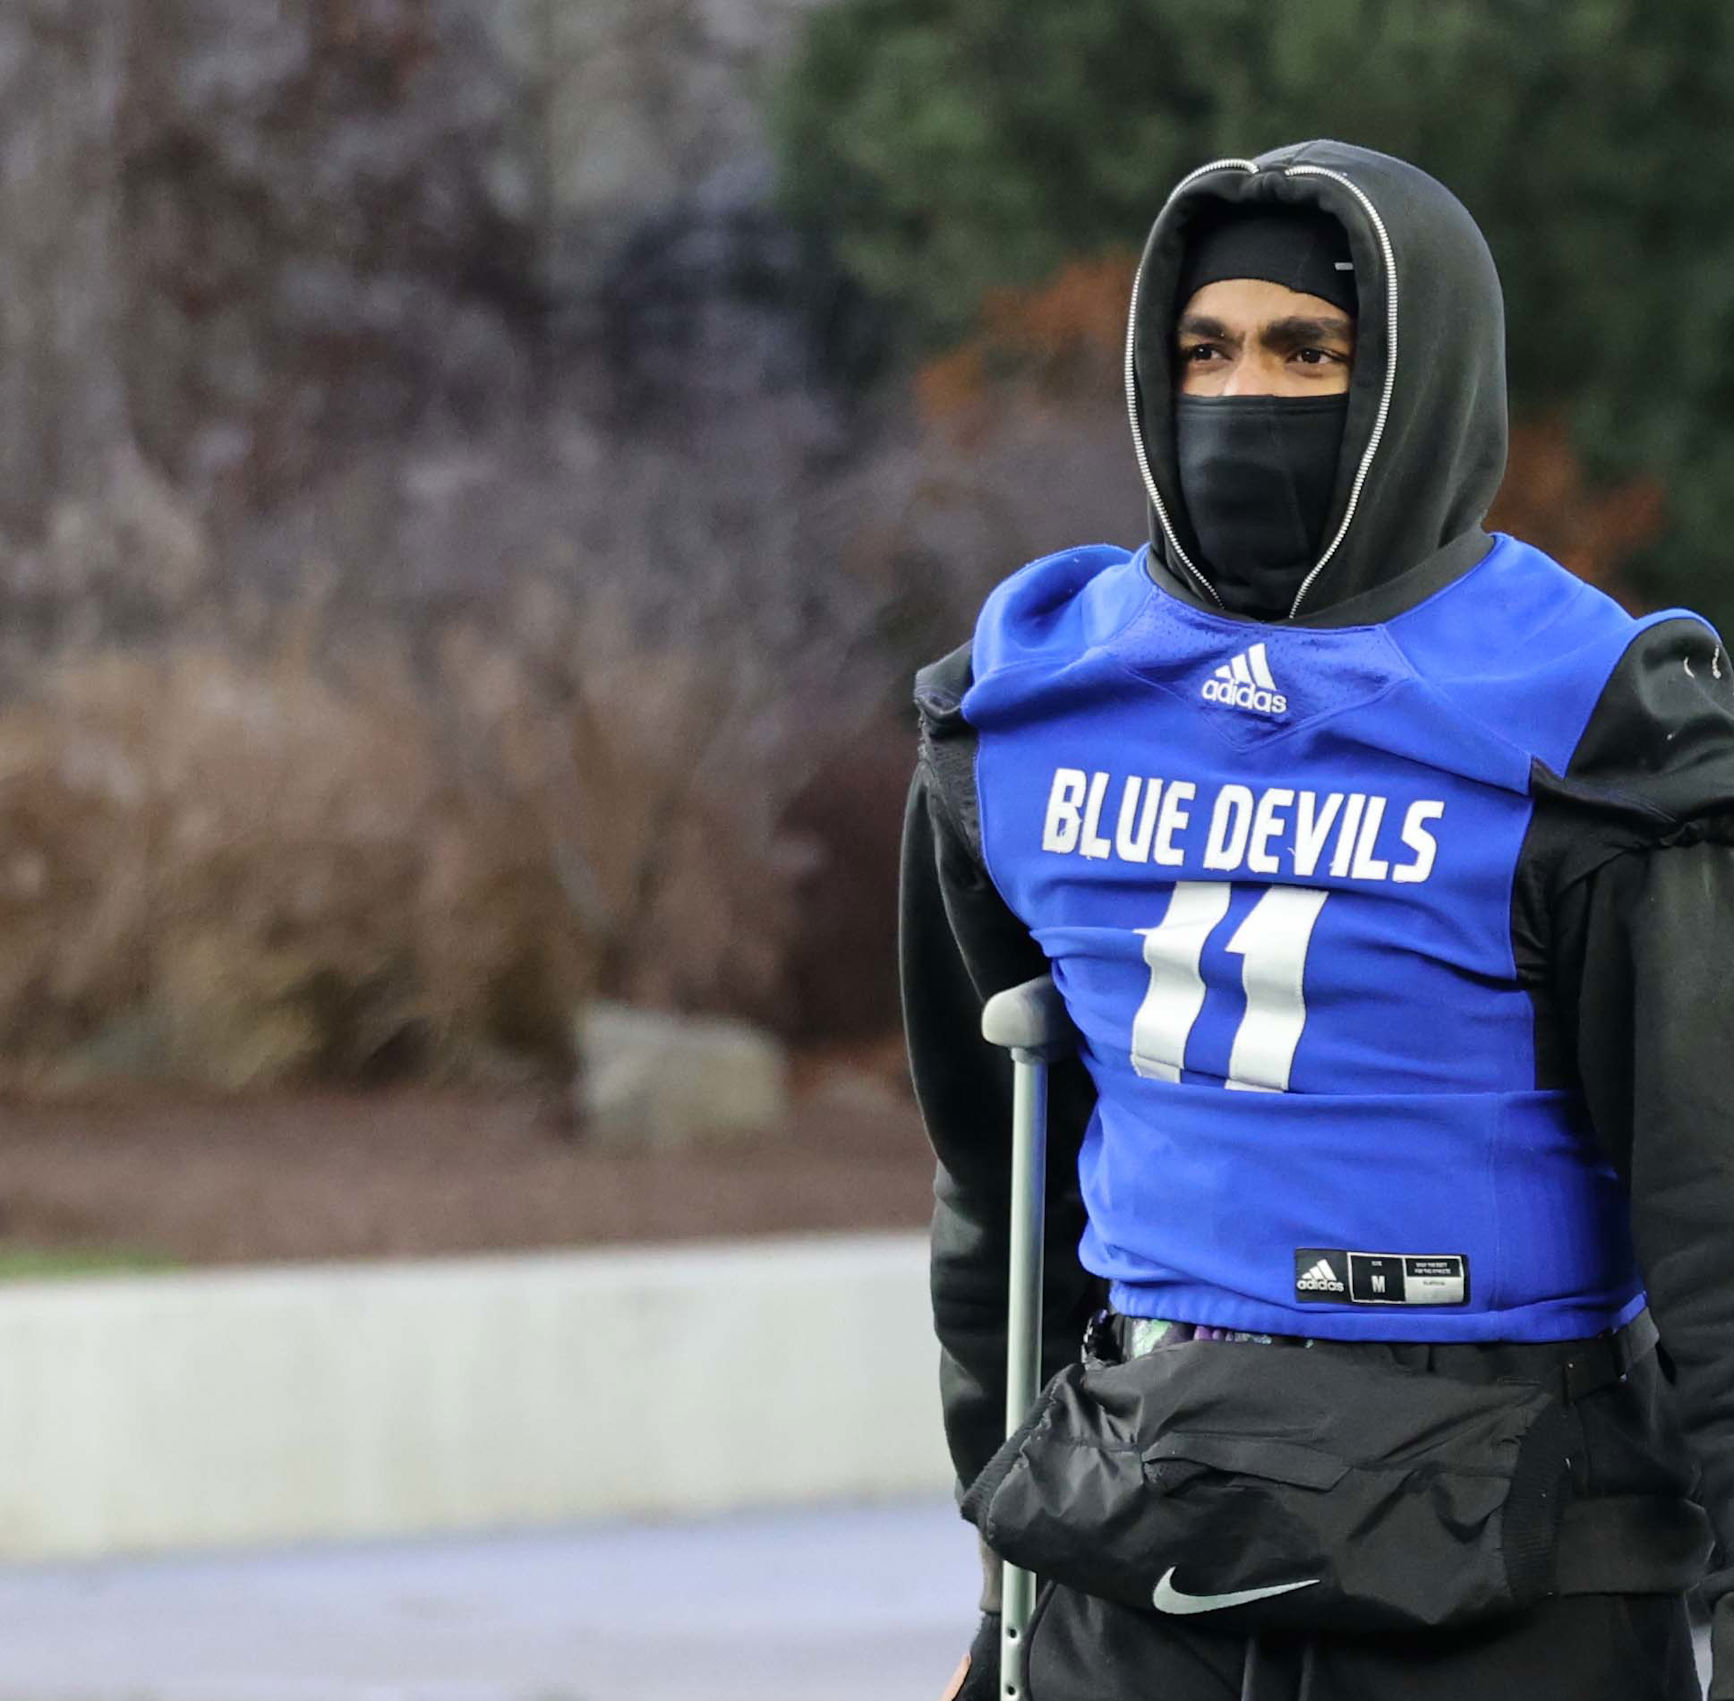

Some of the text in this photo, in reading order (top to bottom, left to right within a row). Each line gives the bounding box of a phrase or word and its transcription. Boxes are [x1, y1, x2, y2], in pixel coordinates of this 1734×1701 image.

[1202, 678, 1287, 714] adidas
[1042, 768, 1444, 883] BLUE DEVILS
[1130, 880, 1330, 1094] 11
[1297, 1278, 1344, 1292] adidas
[1371, 1275, 1386, 1293] M
